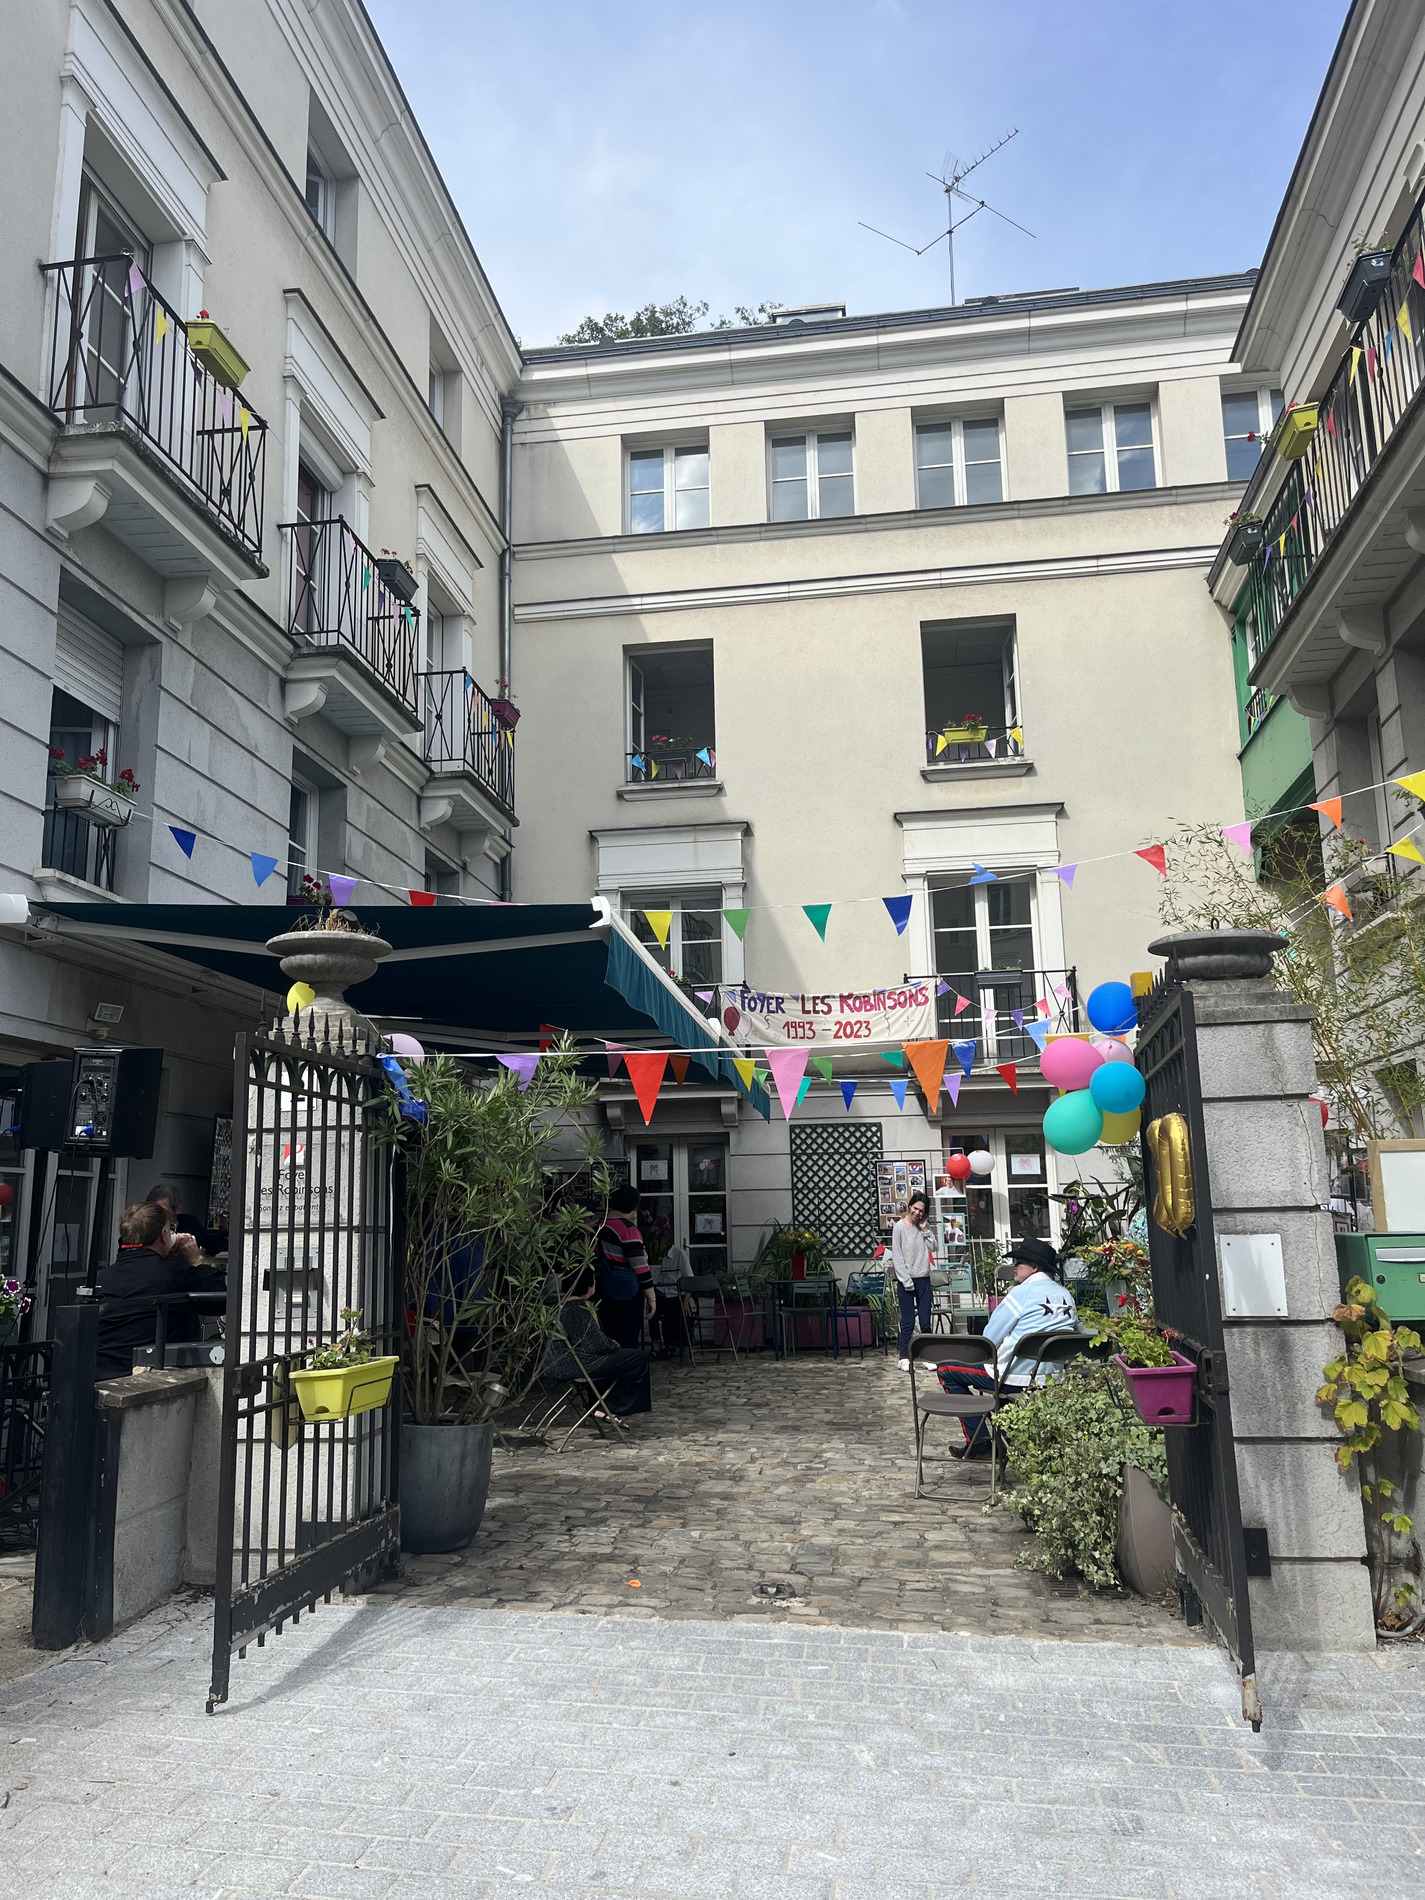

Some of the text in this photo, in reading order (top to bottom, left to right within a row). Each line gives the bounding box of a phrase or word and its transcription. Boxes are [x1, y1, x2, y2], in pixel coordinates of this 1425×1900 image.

[740, 989, 786, 1014] FOYER
[801, 993, 832, 1015] LES
[782, 1020, 816, 1040] 1993
[833, 1020, 872, 1039] 2023
[278, 1169, 308, 1181] Foe
